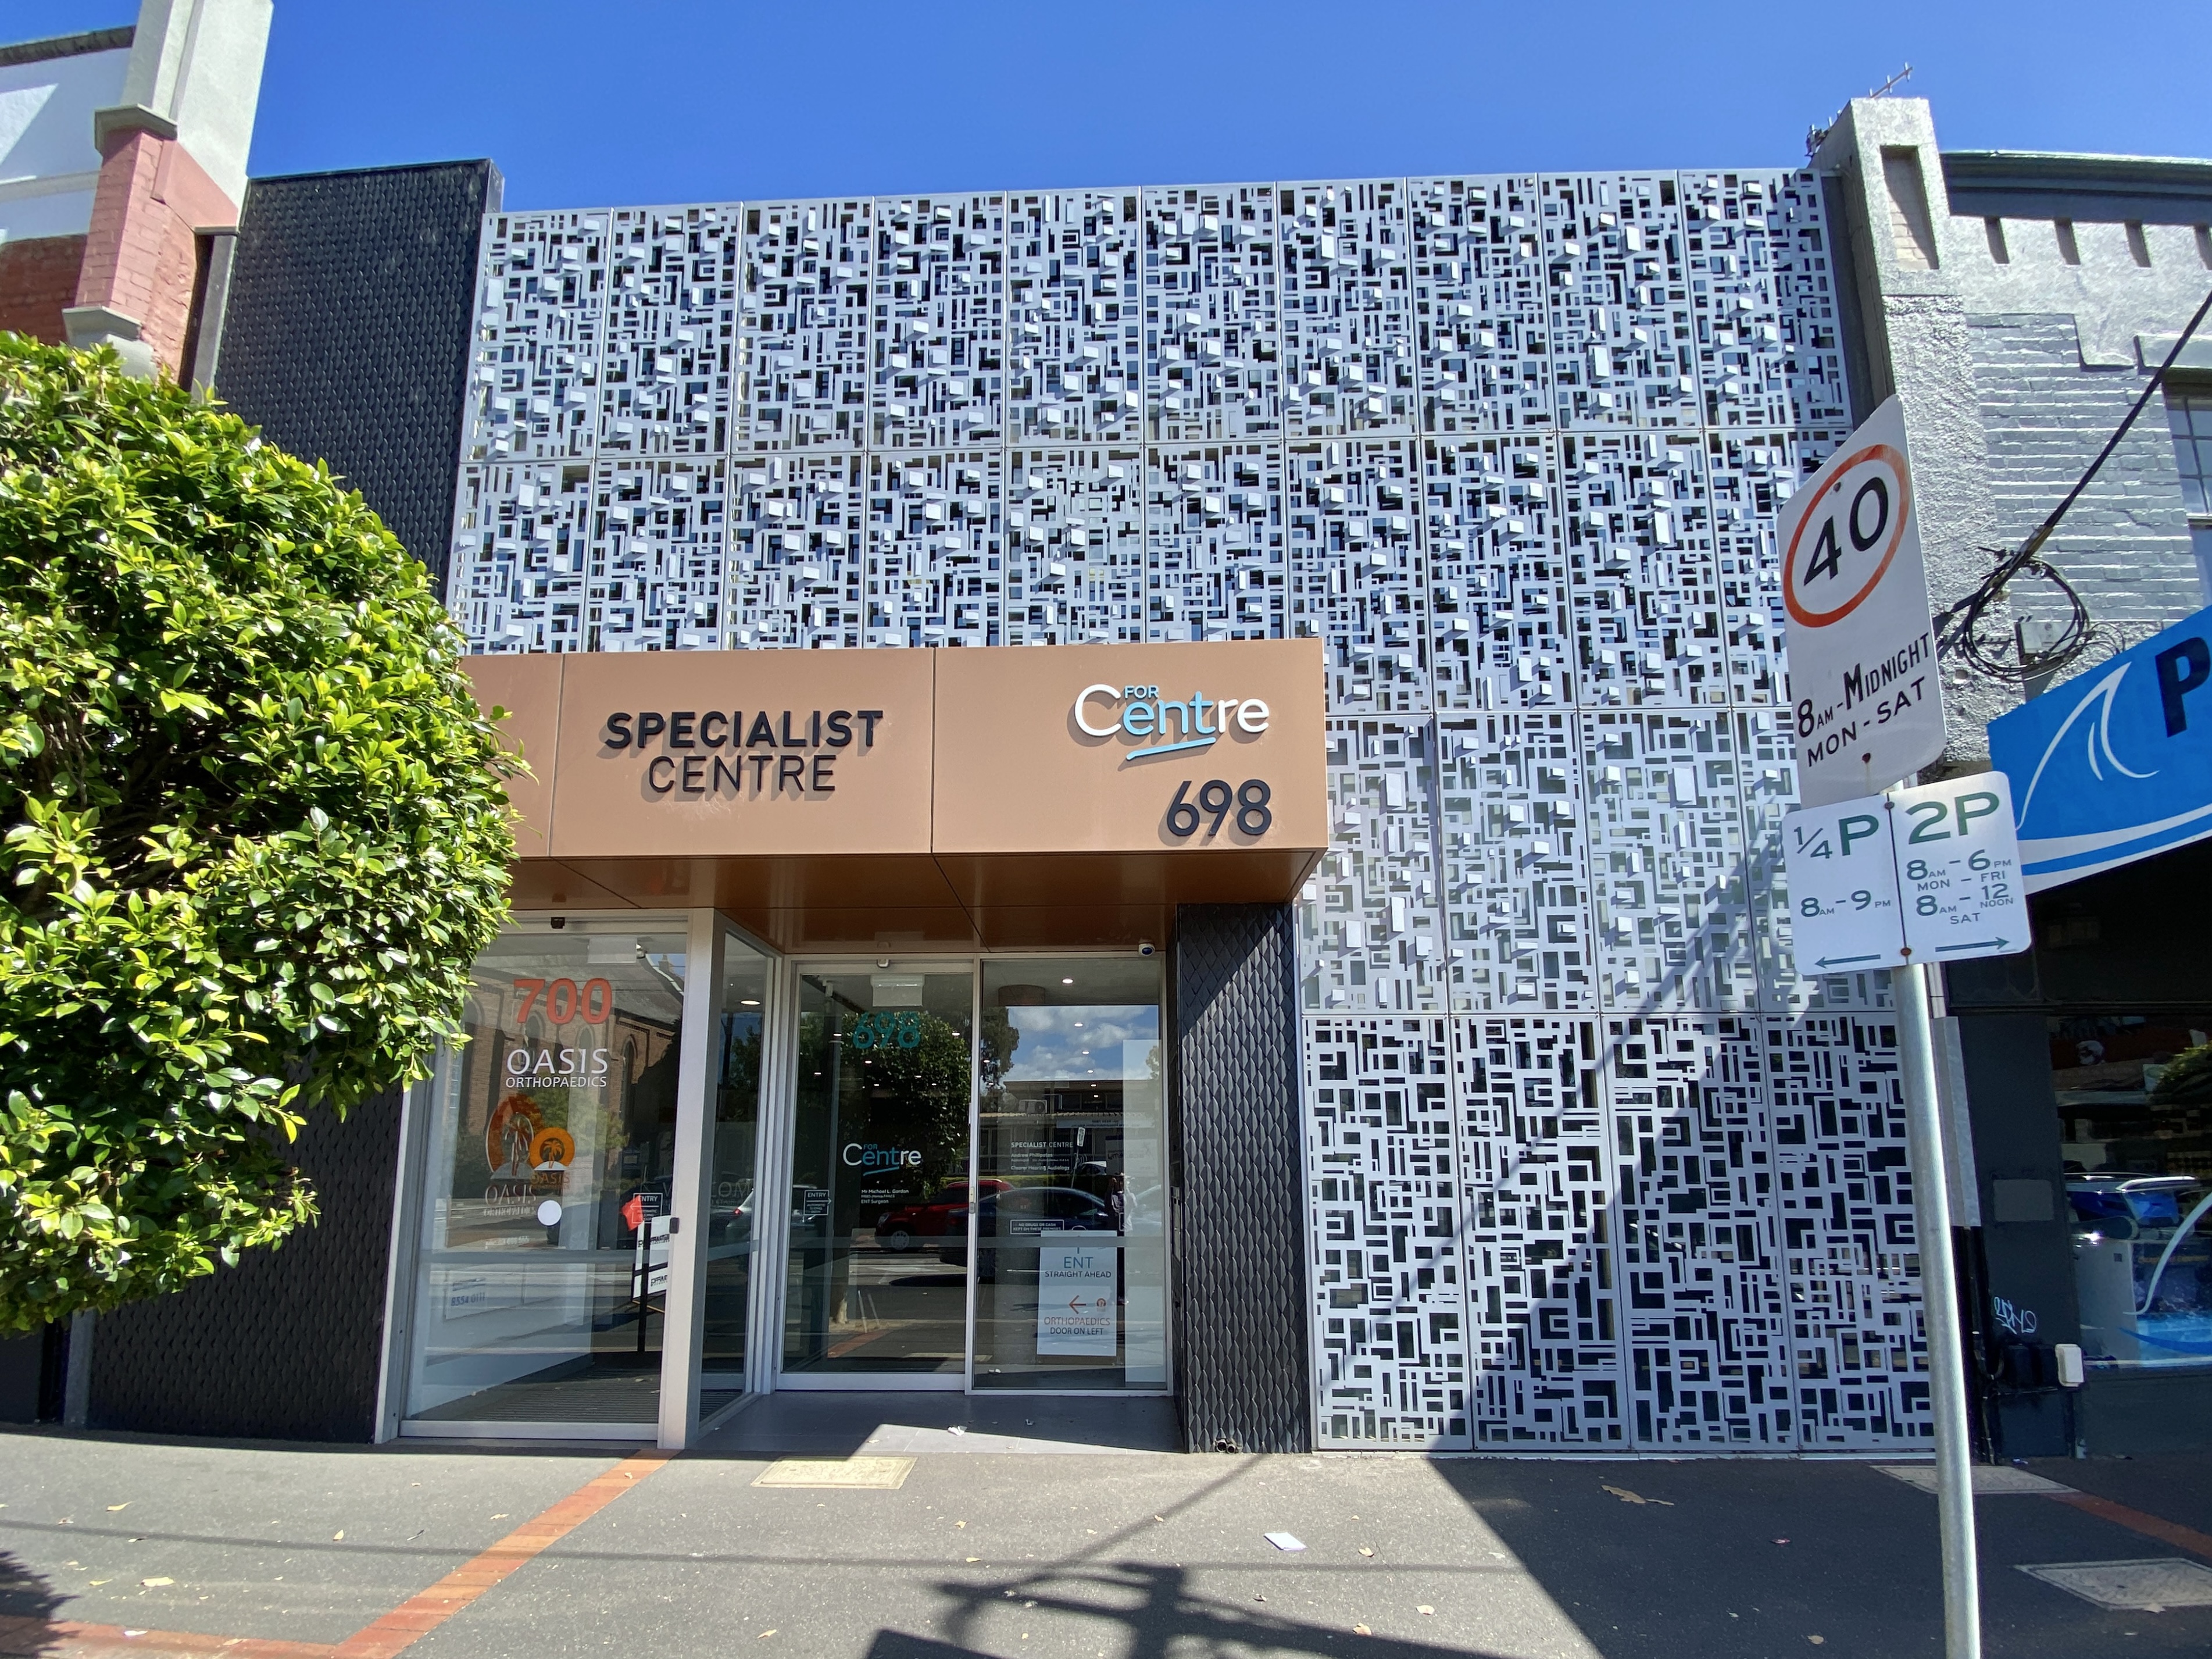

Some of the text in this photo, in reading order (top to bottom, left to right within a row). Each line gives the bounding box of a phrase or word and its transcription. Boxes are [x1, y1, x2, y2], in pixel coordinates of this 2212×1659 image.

[1803, 476, 1889, 587] 40
[1124, 685, 1159, 698] FOR
[2154, 637, 2211, 738] P
[1074, 684, 1269, 737] Centre
[605, 710, 883, 748] SPECIALIST
[648, 754, 837, 793] CENTRE
[1166, 779, 1273, 836] 698
[1905, 791, 2000, 844] 2P
[1917, 879, 1950, 891] MON
[1980, 870, 2006, 883] FRI
[1950, 912, 1981, 925] SAT
[1979, 897, 2014, 909] NOON
[513, 977, 612, 1025] 700
[853, 1011, 920, 1049] 698
[507, 1048, 608, 1075] OASIS
[506, 1076, 607, 1088] ORTHOPAEDICS
[843, 1143, 922, 1166] Centre
[1064, 1257, 1094, 1268] ENT
[1044, 1317, 1110, 1326] ORTHOPAEDICS
